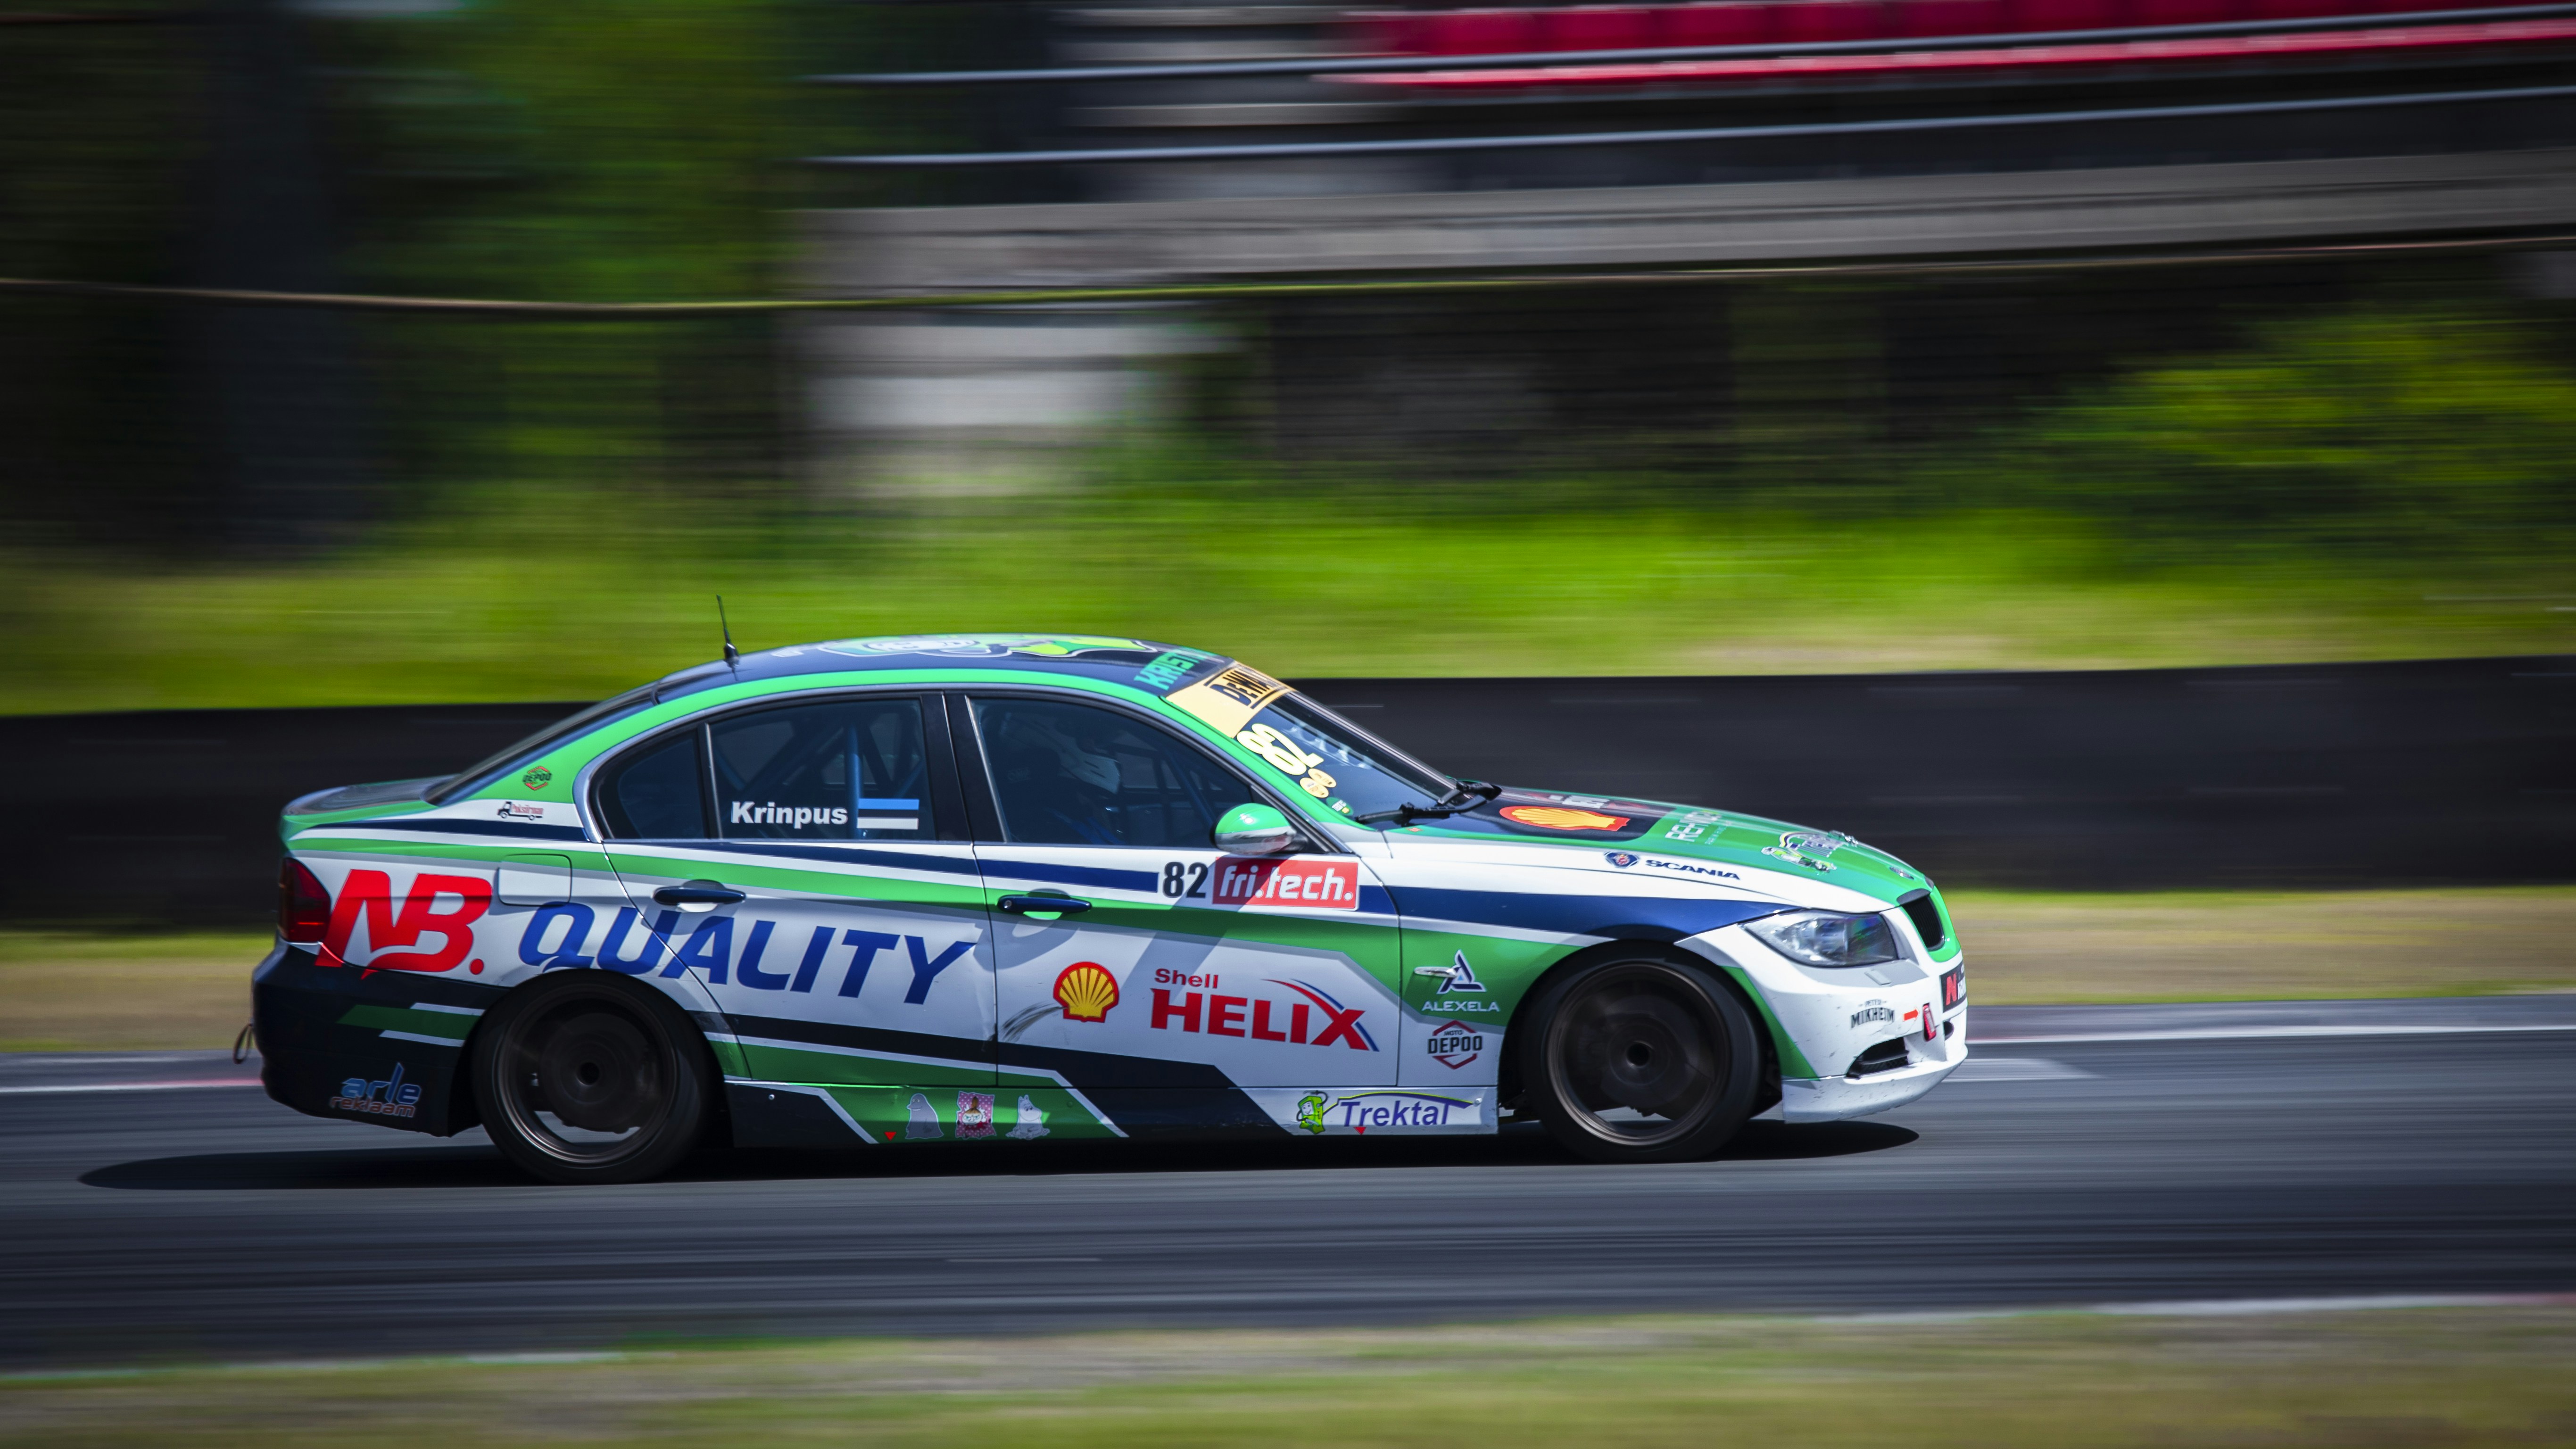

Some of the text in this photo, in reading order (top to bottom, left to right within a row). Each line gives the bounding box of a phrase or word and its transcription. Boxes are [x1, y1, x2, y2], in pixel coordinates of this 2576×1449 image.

[1236, 723, 1325, 776] 82
[731, 801, 848, 829] Krinpus
[1163, 861, 1209, 899] 82
[1645, 859, 1740, 880] SCANIA
[518, 901, 978, 1005] QUALITY
[1154, 968, 1219, 989] Shell
[1150, 985, 1371, 1052] HELIX
[1421, 1000, 1500, 1012] ALEXELA
[1850, 1007, 1895, 1029] MIKHEIM
[340, 1061, 422, 1105] arle
[330, 1094, 416, 1118] reklaam
[1340, 1100, 1450, 1127] Trektal
